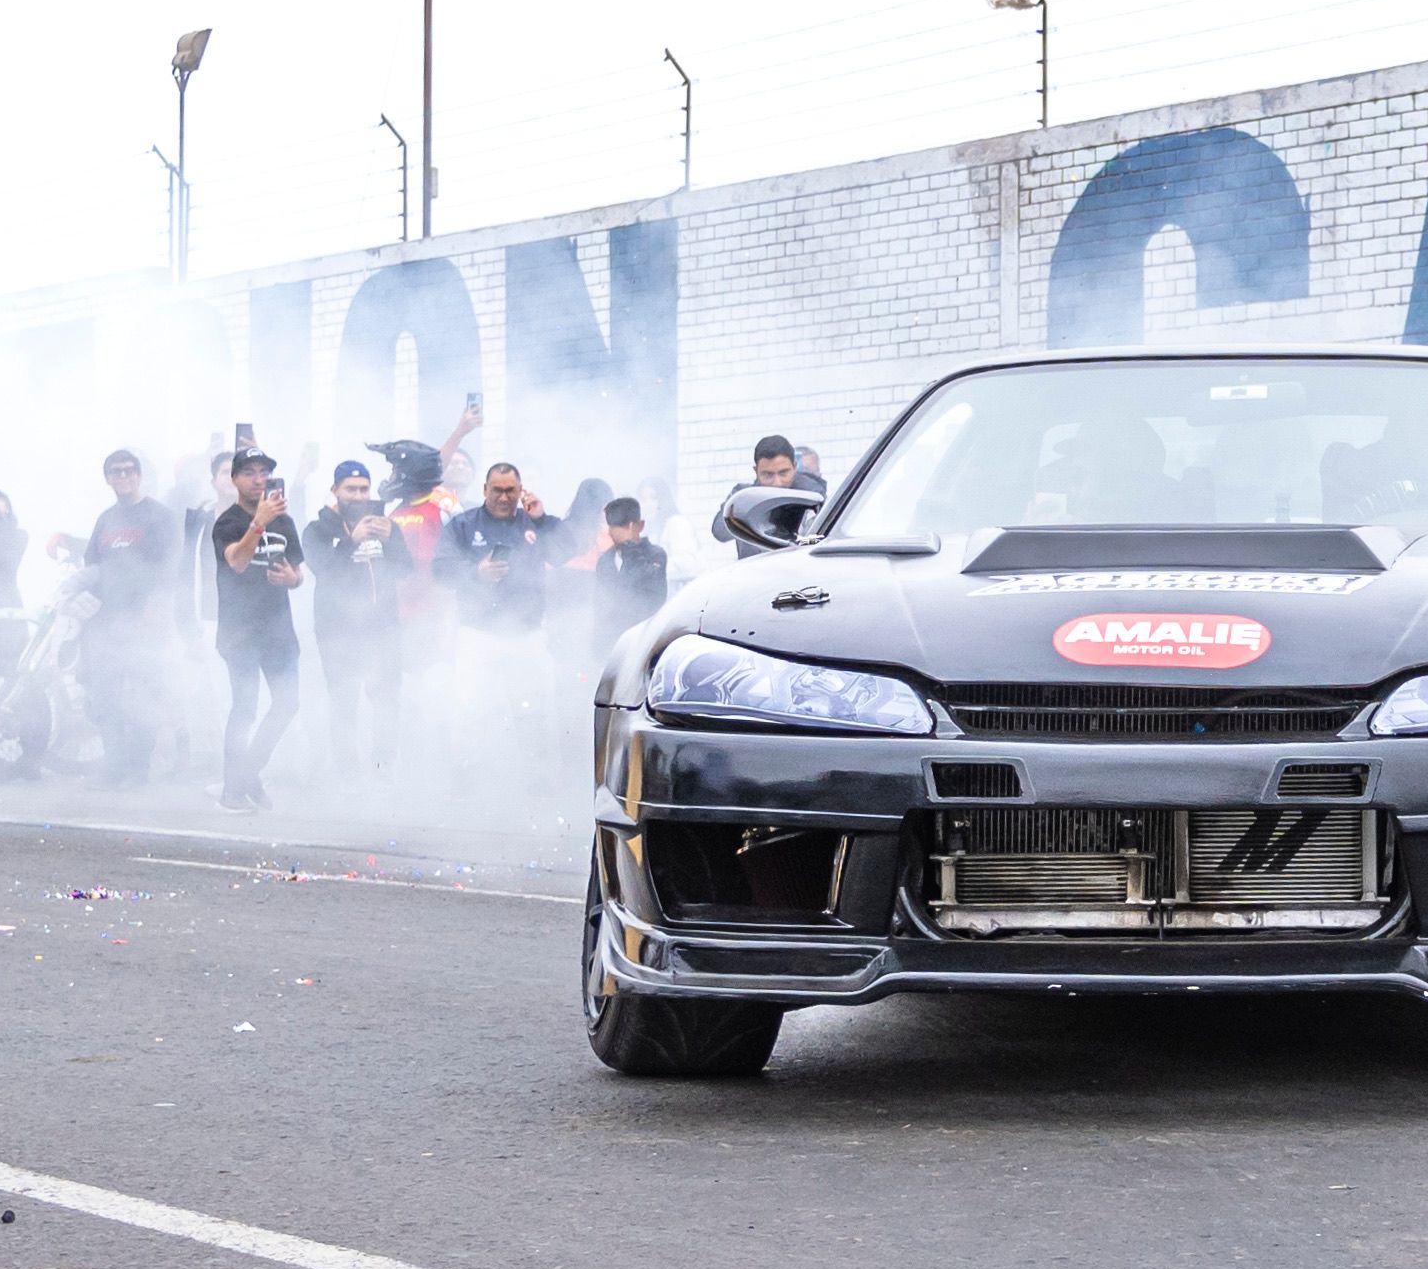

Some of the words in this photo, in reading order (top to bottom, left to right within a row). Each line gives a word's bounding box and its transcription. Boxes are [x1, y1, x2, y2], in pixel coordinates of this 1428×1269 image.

[1064, 620, 1264, 645] AMALIE
[1113, 645, 1174, 656] MOTOR
[1177, 645, 1206, 656] OIL
